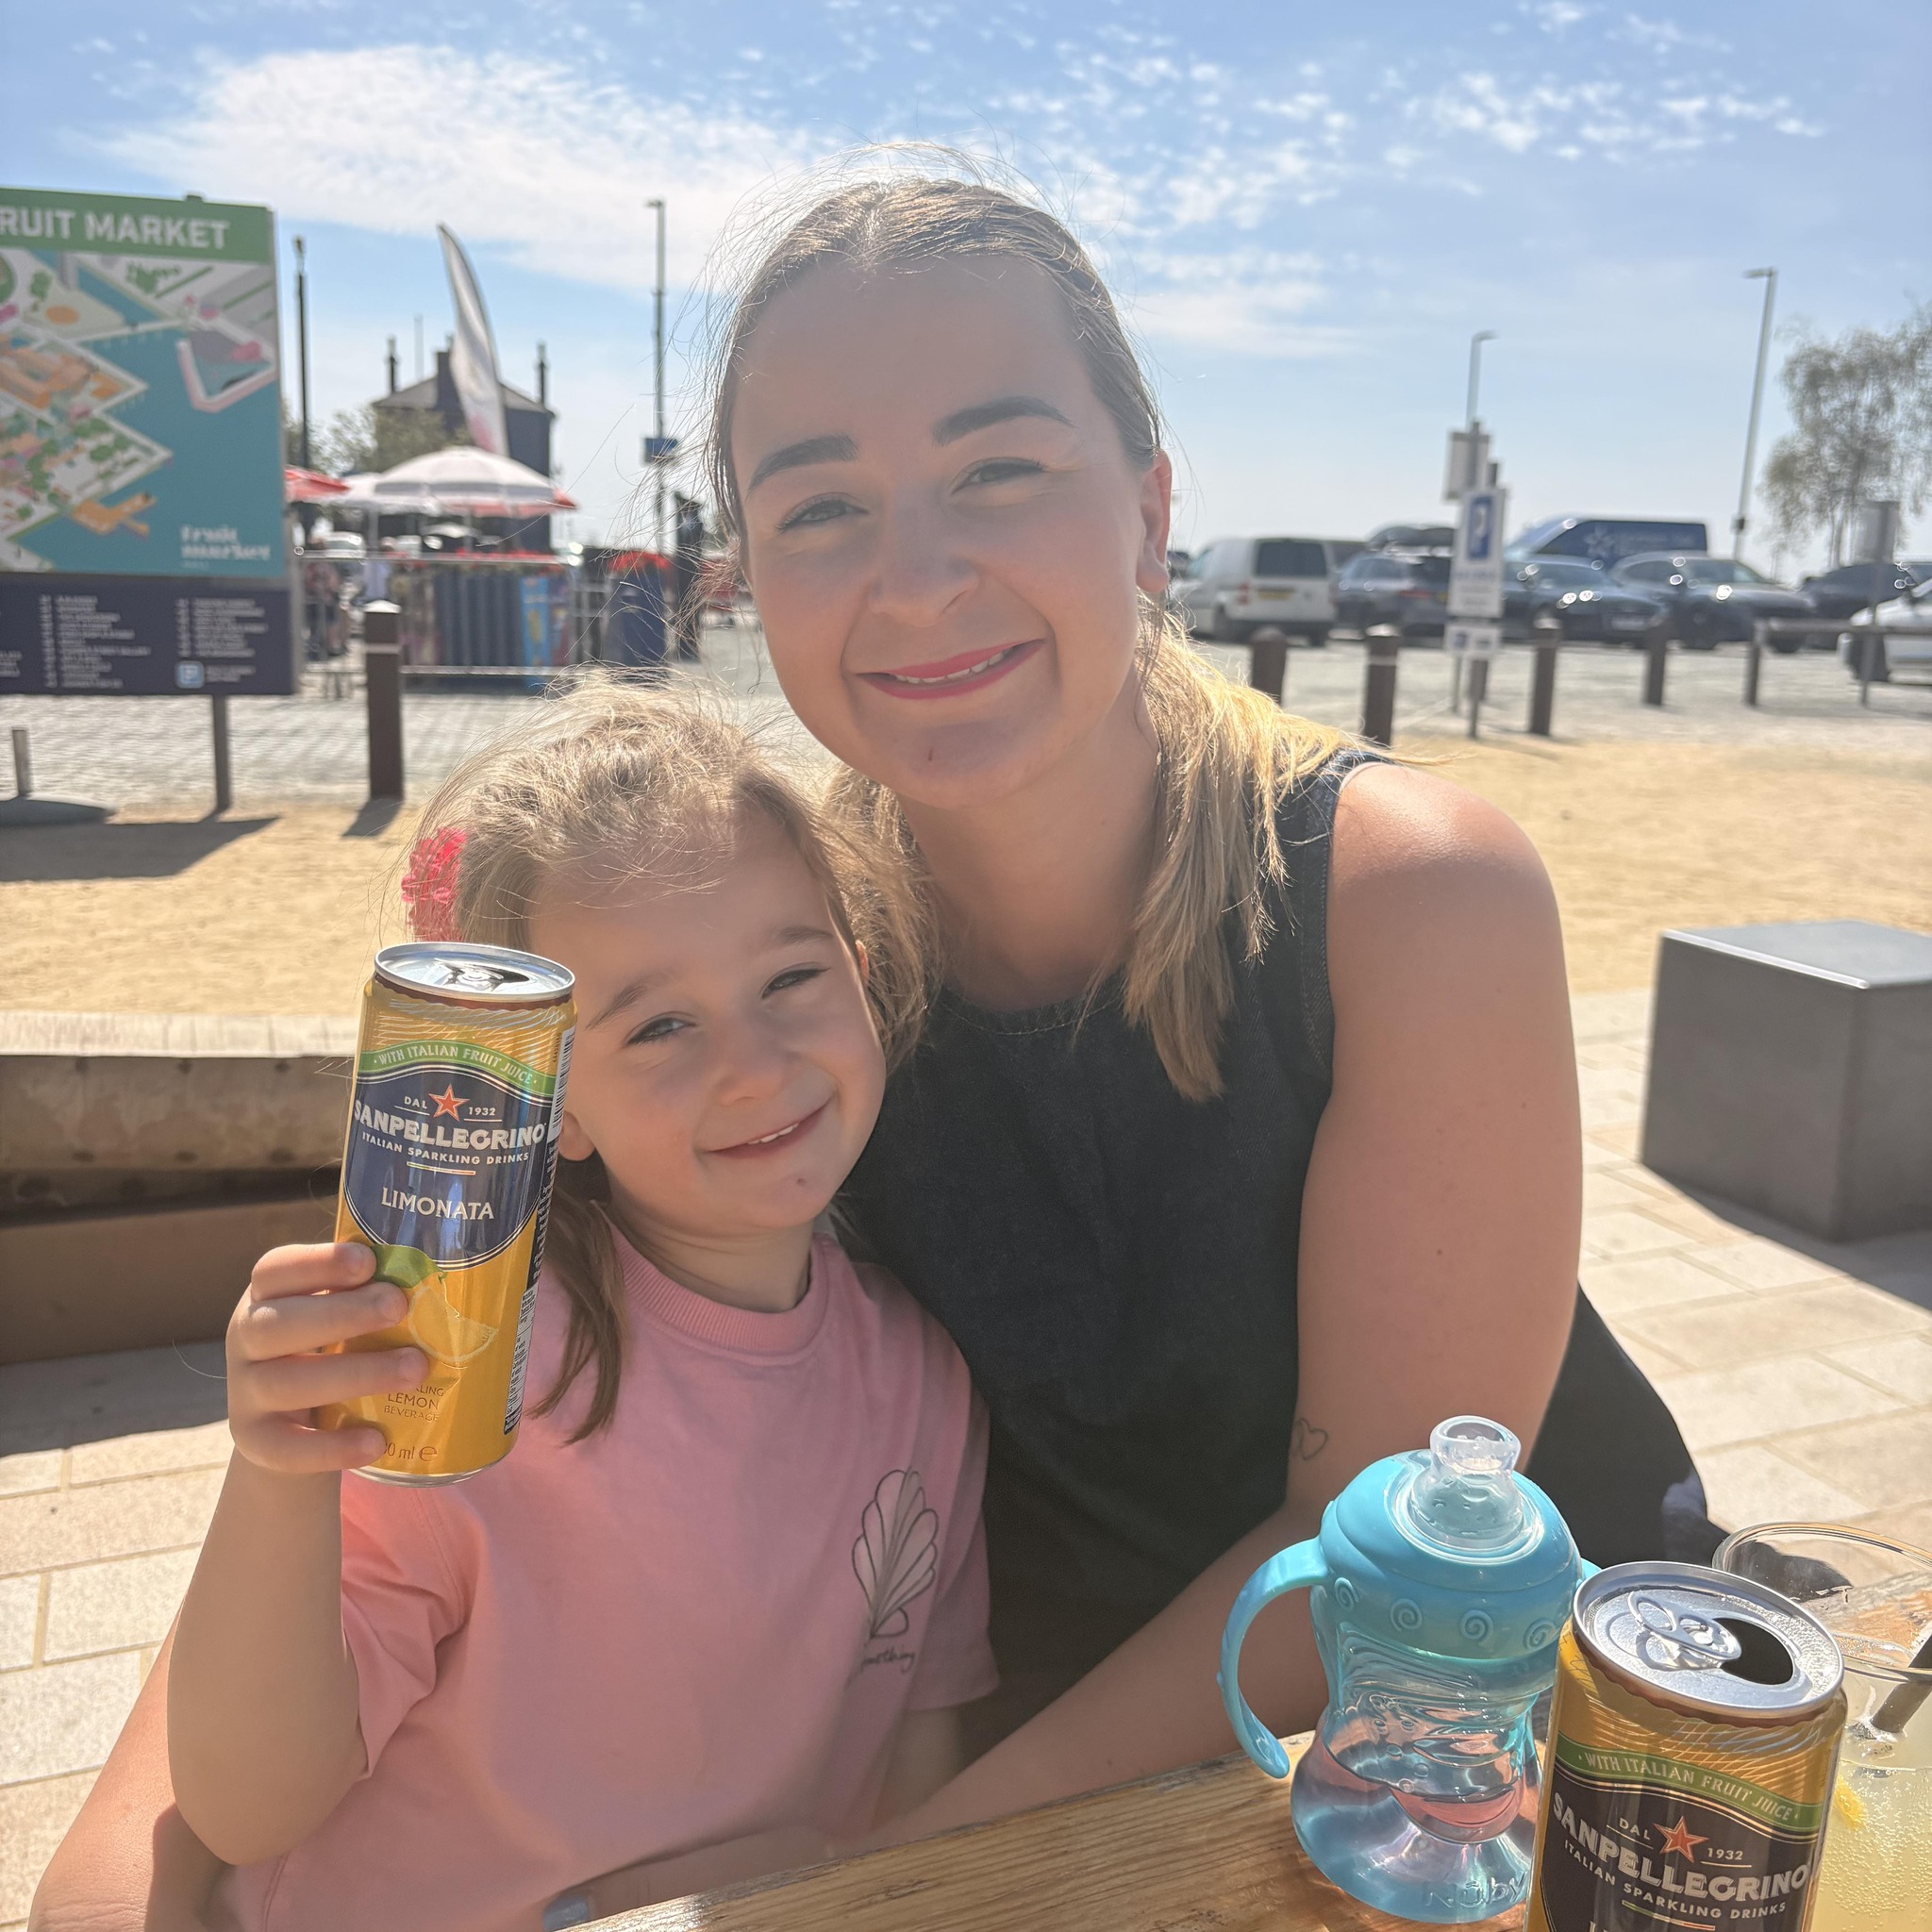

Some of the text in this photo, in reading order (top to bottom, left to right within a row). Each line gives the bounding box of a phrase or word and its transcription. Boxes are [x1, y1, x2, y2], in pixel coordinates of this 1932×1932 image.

[84, 212, 231, 249] MARKET
[378, 1044, 533, 1084] WITH ITALIAN FRUIT JUICE
[404, 1095, 497, 1117] DAL 1932
[353, 1099, 546, 1151] SANPELLEGRINO
[362, 1131, 529, 1166] ITALIAN SPARKLING DRINKS
[381, 1186, 494, 1221] LIMONATA
[388, 1391, 439, 1410] LEMON
[416, 1384, 444, 1397] LING
[384, 1405, 440, 1423] BEVERAGE
[398, 1446, 415, 1460] ml
[1584, 1752, 1793, 1822] WITH ITALIAN FRUIT JUICE
[1552, 1791, 1811, 1903] SANPELLEGRINO
[1619, 1817, 1743, 1861] DAL 1932
[1564, 1840, 1786, 1920] ITALIAN SPARKLING DRINKS
